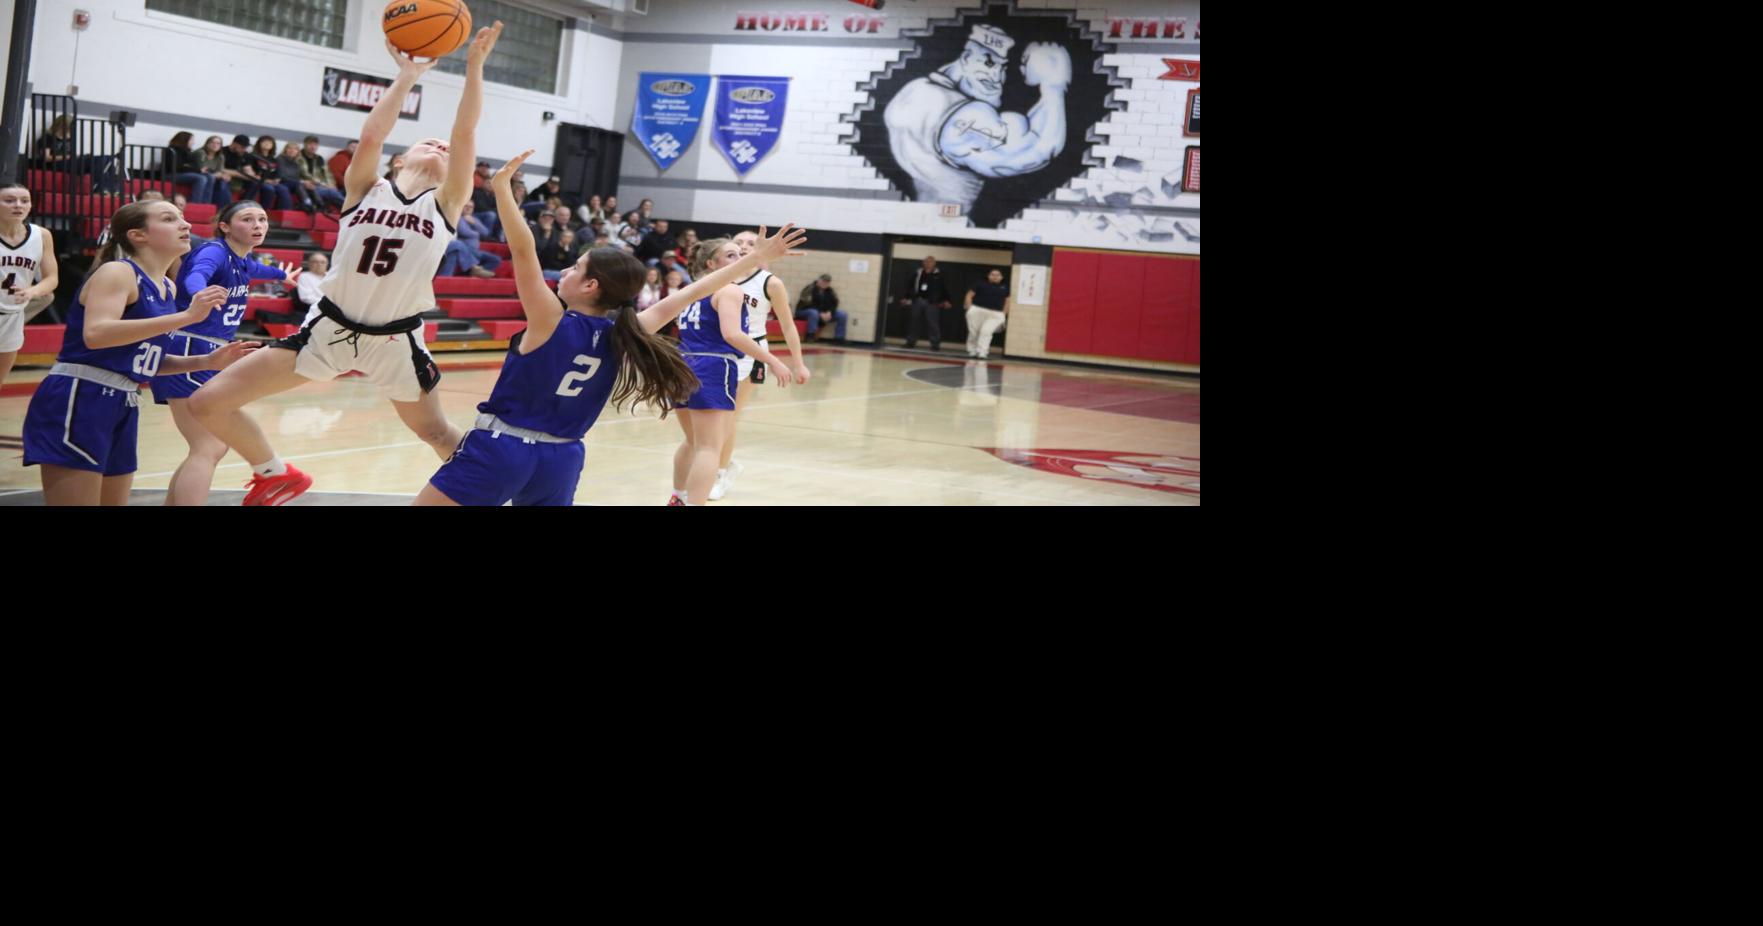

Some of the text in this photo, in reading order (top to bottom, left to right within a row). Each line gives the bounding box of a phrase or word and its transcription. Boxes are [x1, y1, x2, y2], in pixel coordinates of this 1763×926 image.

[385, 3, 417, 20] NCAA
[734, 11, 888, 33] HOME OF
[983, 33, 1005, 48] LHS
[1104, 16, 1186, 39] THE
[338, 78, 420, 115] LAKEW
[348, 207, 435, 239] SAILORS
[356, 235, 405, 277] 15
[1, 272, 16, 296] 4
[132, 341, 162, 378] 20
[555, 353, 602, 397] 2
